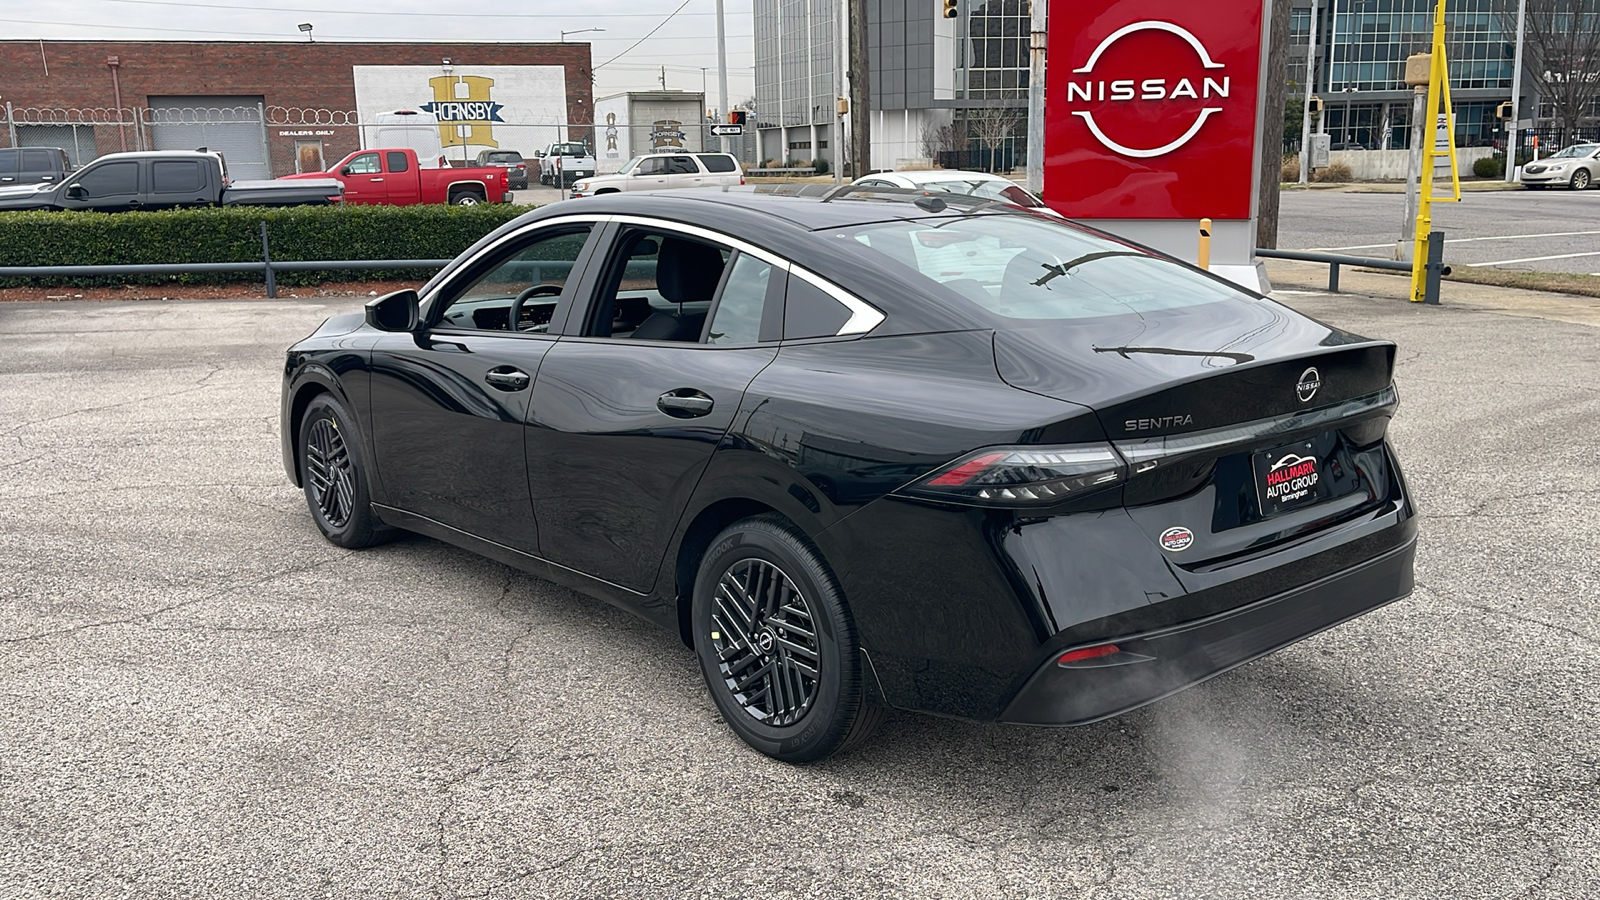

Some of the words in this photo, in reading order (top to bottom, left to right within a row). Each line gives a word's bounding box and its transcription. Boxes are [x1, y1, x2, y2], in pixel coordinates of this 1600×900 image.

[1067, 76, 1230, 103] NISSAN
[432, 102, 494, 121] HORNSBY
[1296, 381, 1321, 392] NISSAN
[1124, 414, 1194, 432] SENTRA
[1266, 461, 1316, 486] HALLMARK
[1266, 482, 1290, 499] AUTO
[1291, 472, 1319, 491] GROUP
[1281, 489, 1309, 503] Birmingham
